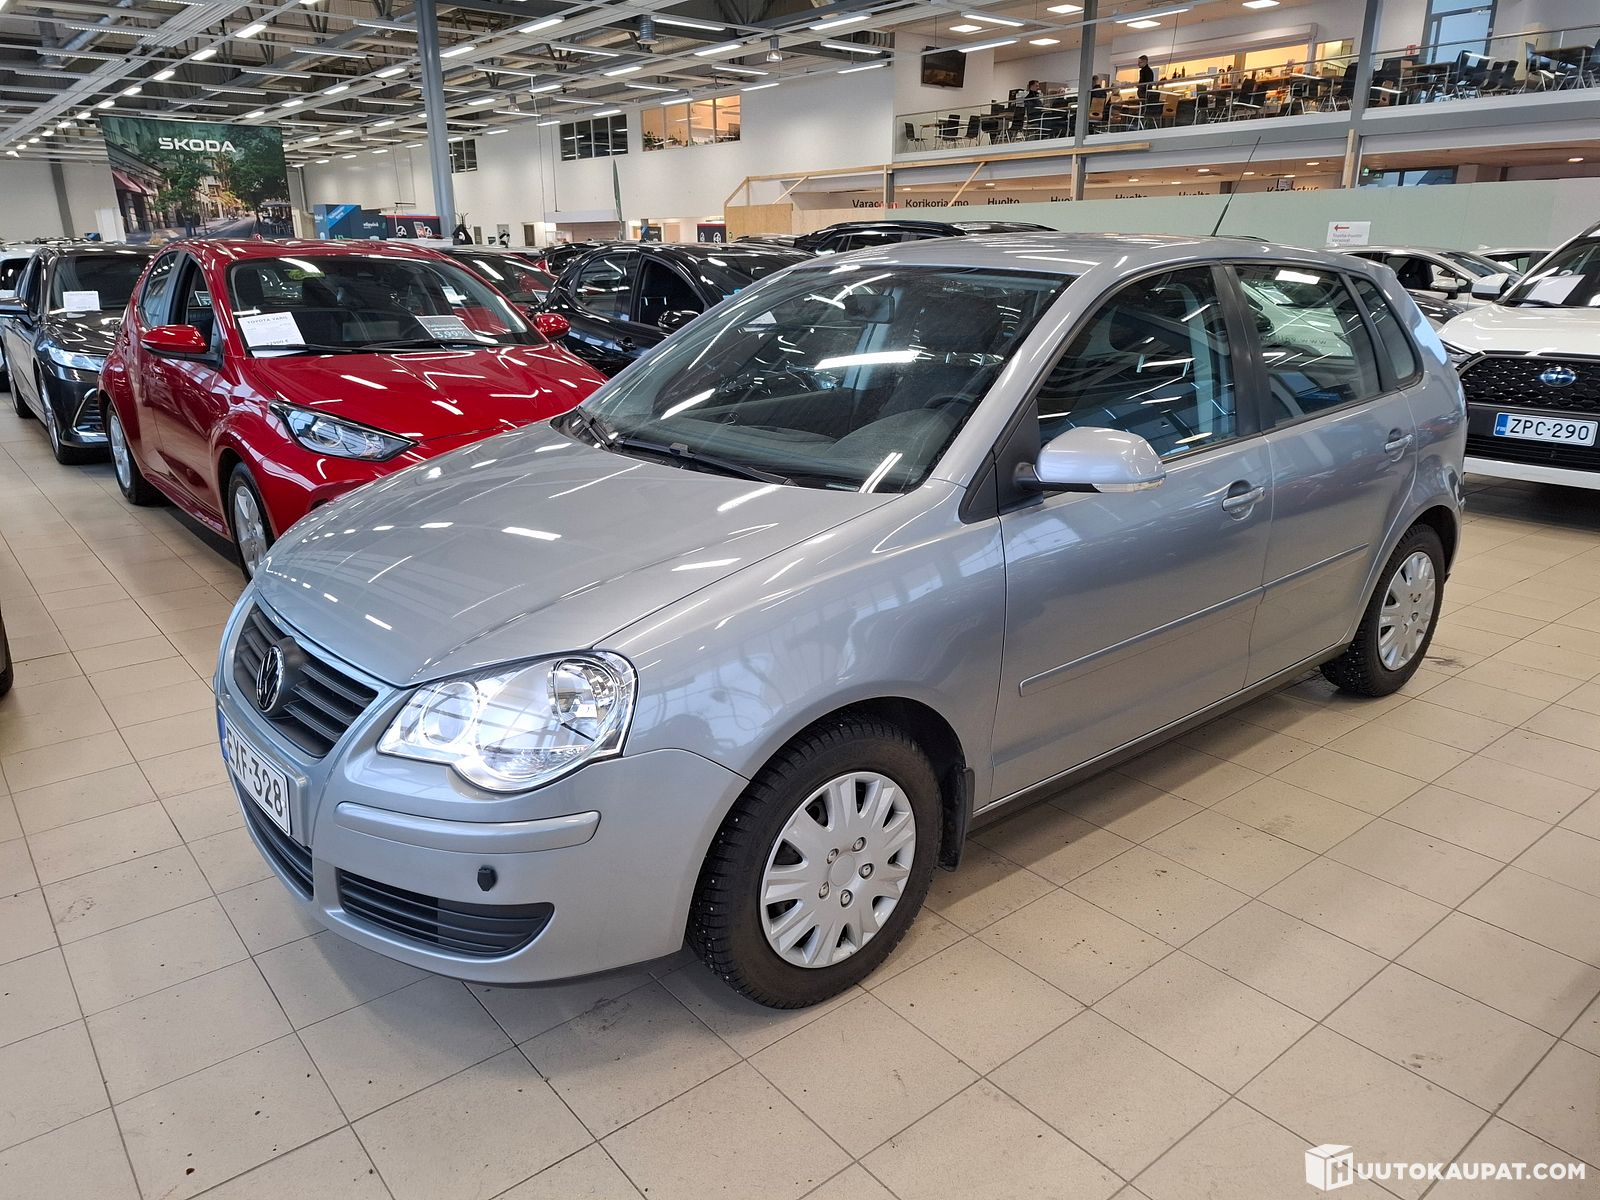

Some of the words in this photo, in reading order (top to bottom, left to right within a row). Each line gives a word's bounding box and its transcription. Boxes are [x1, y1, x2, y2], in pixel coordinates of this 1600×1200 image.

[852, 199, 884, 208] Varao
[1510, 418, 1590, 441] ZPC-290
[226, 726, 283, 818] EXF-328
